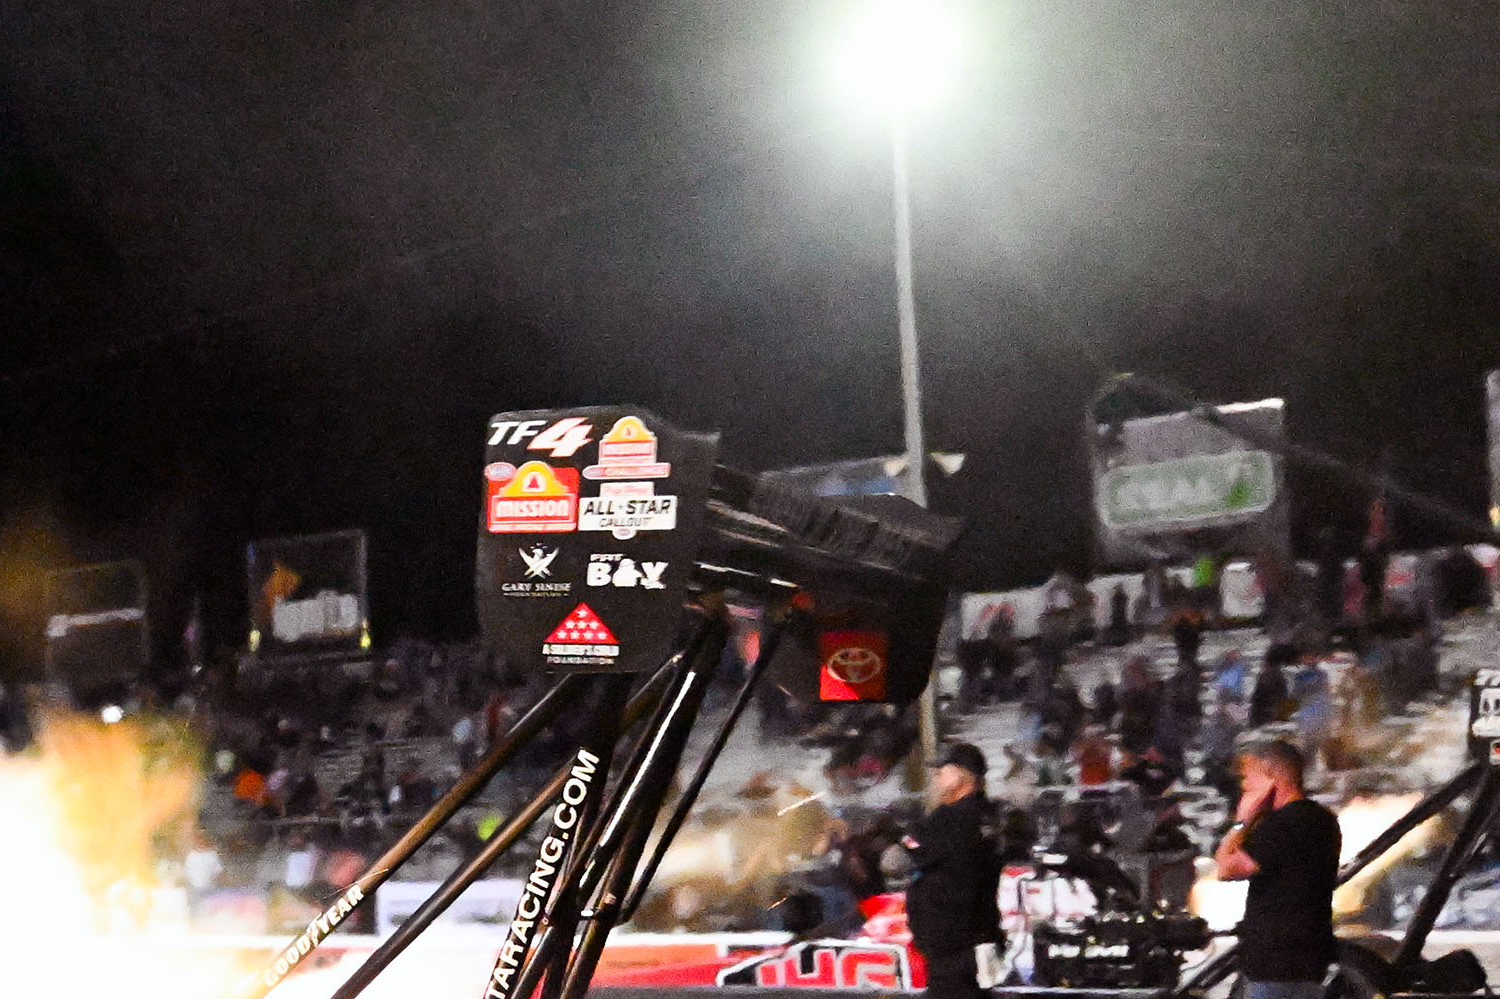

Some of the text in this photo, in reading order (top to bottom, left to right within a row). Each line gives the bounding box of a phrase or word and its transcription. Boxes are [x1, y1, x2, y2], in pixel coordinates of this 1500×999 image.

[488, 417, 594, 457] TF4
[496, 500, 569, 518] MISSION
[265, 885, 364, 987] GOODYEAR
